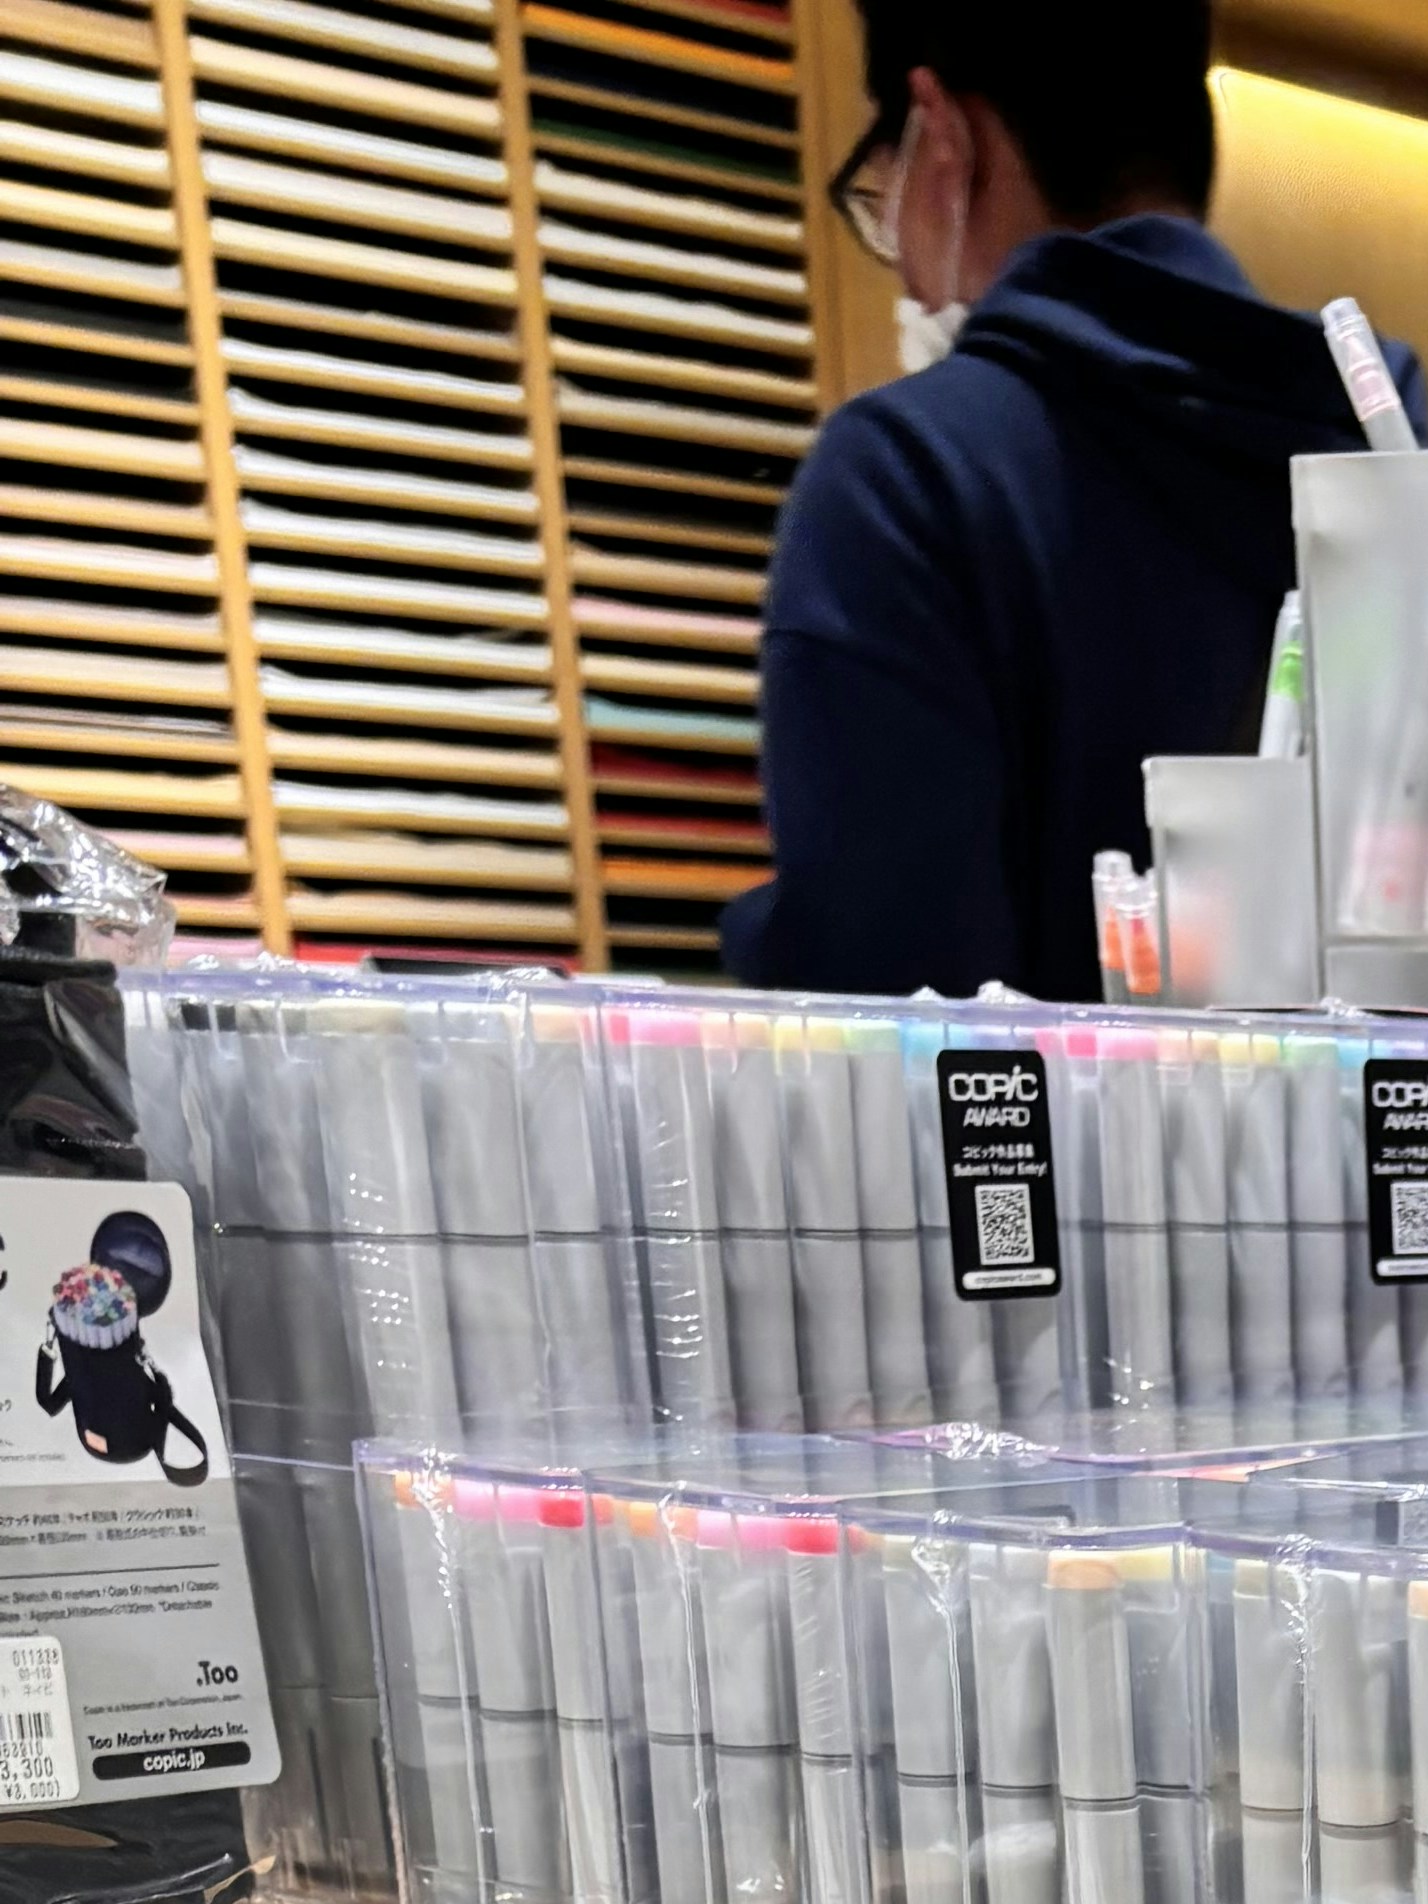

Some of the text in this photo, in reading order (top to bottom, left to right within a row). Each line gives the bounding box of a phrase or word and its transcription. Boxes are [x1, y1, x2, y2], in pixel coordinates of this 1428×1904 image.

[963, 1106, 1030, 1127] AWARD
[116, 1728, 166, 1748] Marker
[169, 1722, 223, 1743] Products
[226, 1720, 248, 1738] Inc.
[143, 1747, 206, 1774] copic.jp
